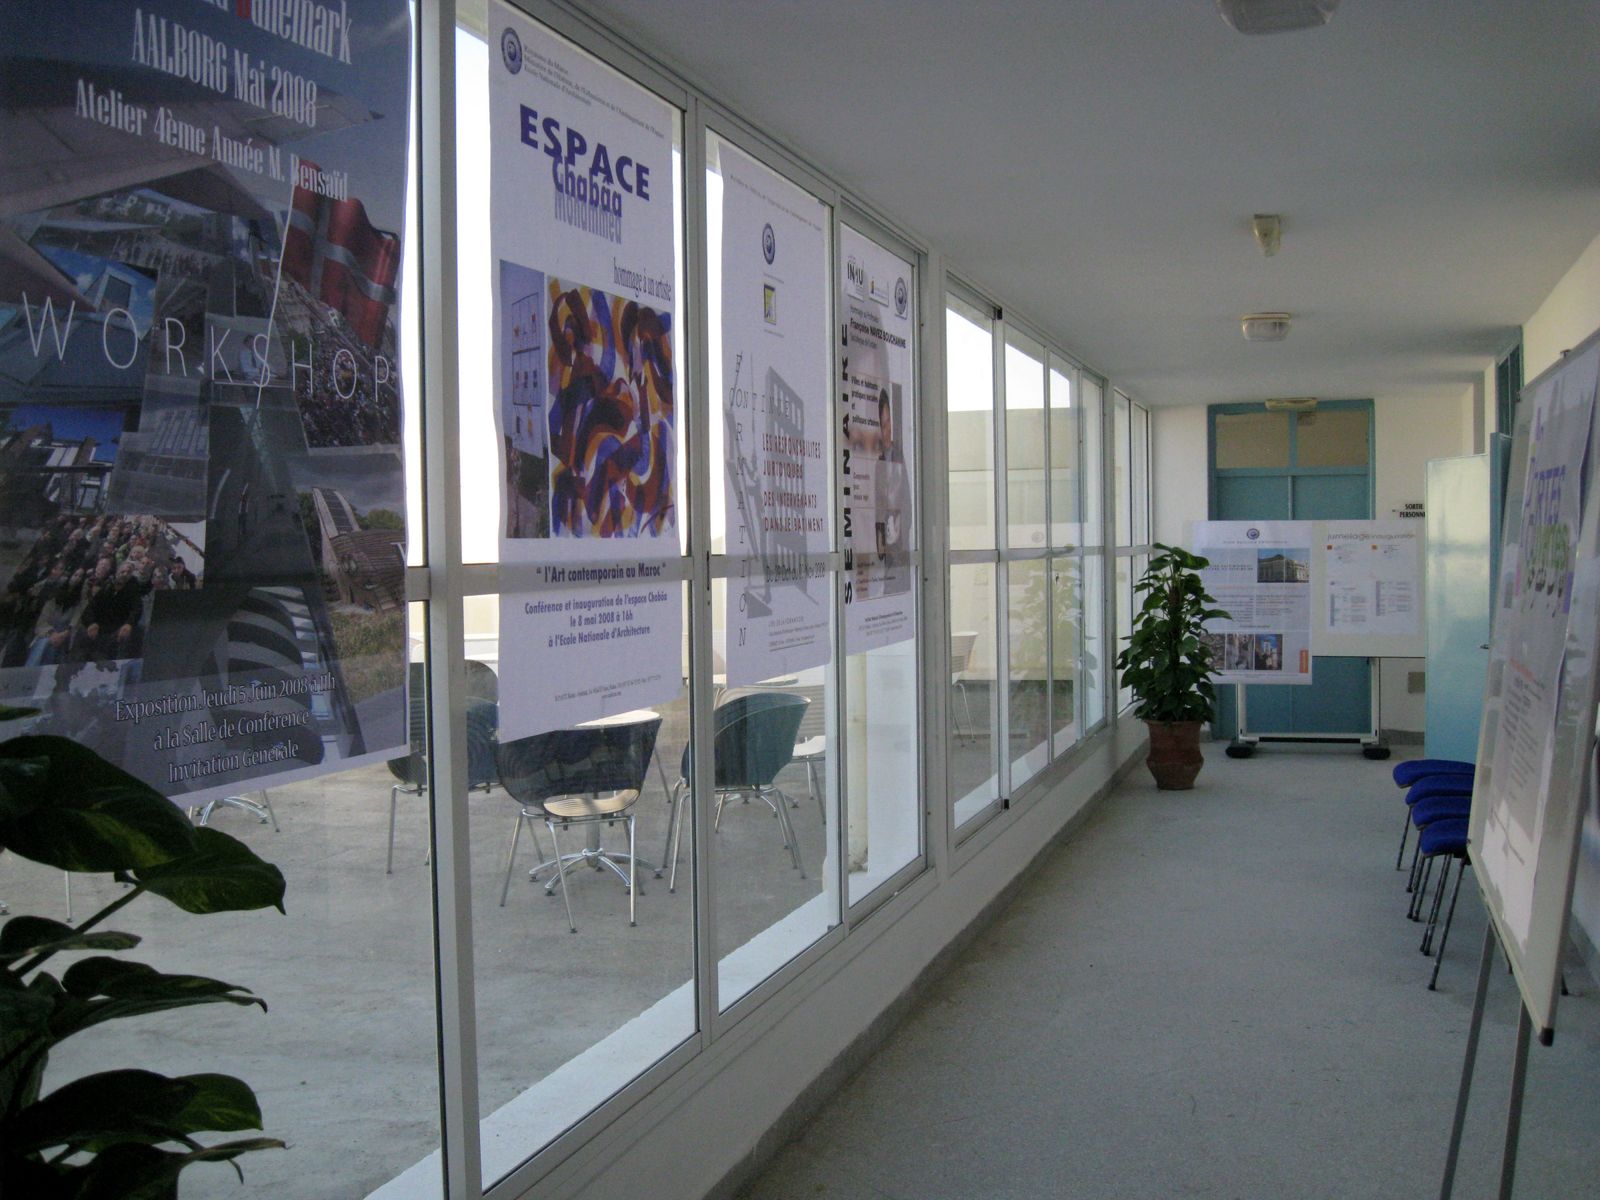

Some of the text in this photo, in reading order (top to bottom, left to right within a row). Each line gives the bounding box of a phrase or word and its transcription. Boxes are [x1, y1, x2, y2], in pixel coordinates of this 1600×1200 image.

[236, 0, 353, 64] anemark
[131, 8, 318, 128] AALBORG Mai 2008
[75, 78, 147, 137] Atelier
[154, 106, 206, 156] 4ème
[211, 126, 264, 175] Année
[268, 145, 285, 183] M.
[520, 103, 650, 201] ESPACE
[613, 256, 672, 302] hommage à un artiste
[21, 290, 390, 409] WORKSHOP
[544, 562, 661, 584] l'Art contemporain au Maroc
[525, 600, 563, 615] Conférence
[565, 600, 572, 611] et
[573, 596, 614, 611] inauguration
[615, 595, 623, 605] de
[570, 610, 633, 627] le 8 mai 2008 à 16h
[548, 625, 650, 648] à l'Ecole Nationale d'Architecture
[115, 692, 198, 723] Exposition
[199, 684, 237, 711] Jeudi
[239, 685, 246, 701] 5
[248, 681, 277, 704] Juin
[279, 678, 308, 698] 2008
[166, 727, 180, 749] la
[183, 720, 216, 747] Salle
[218, 718, 235, 740] de
[168, 753, 240, 783] Invitation
